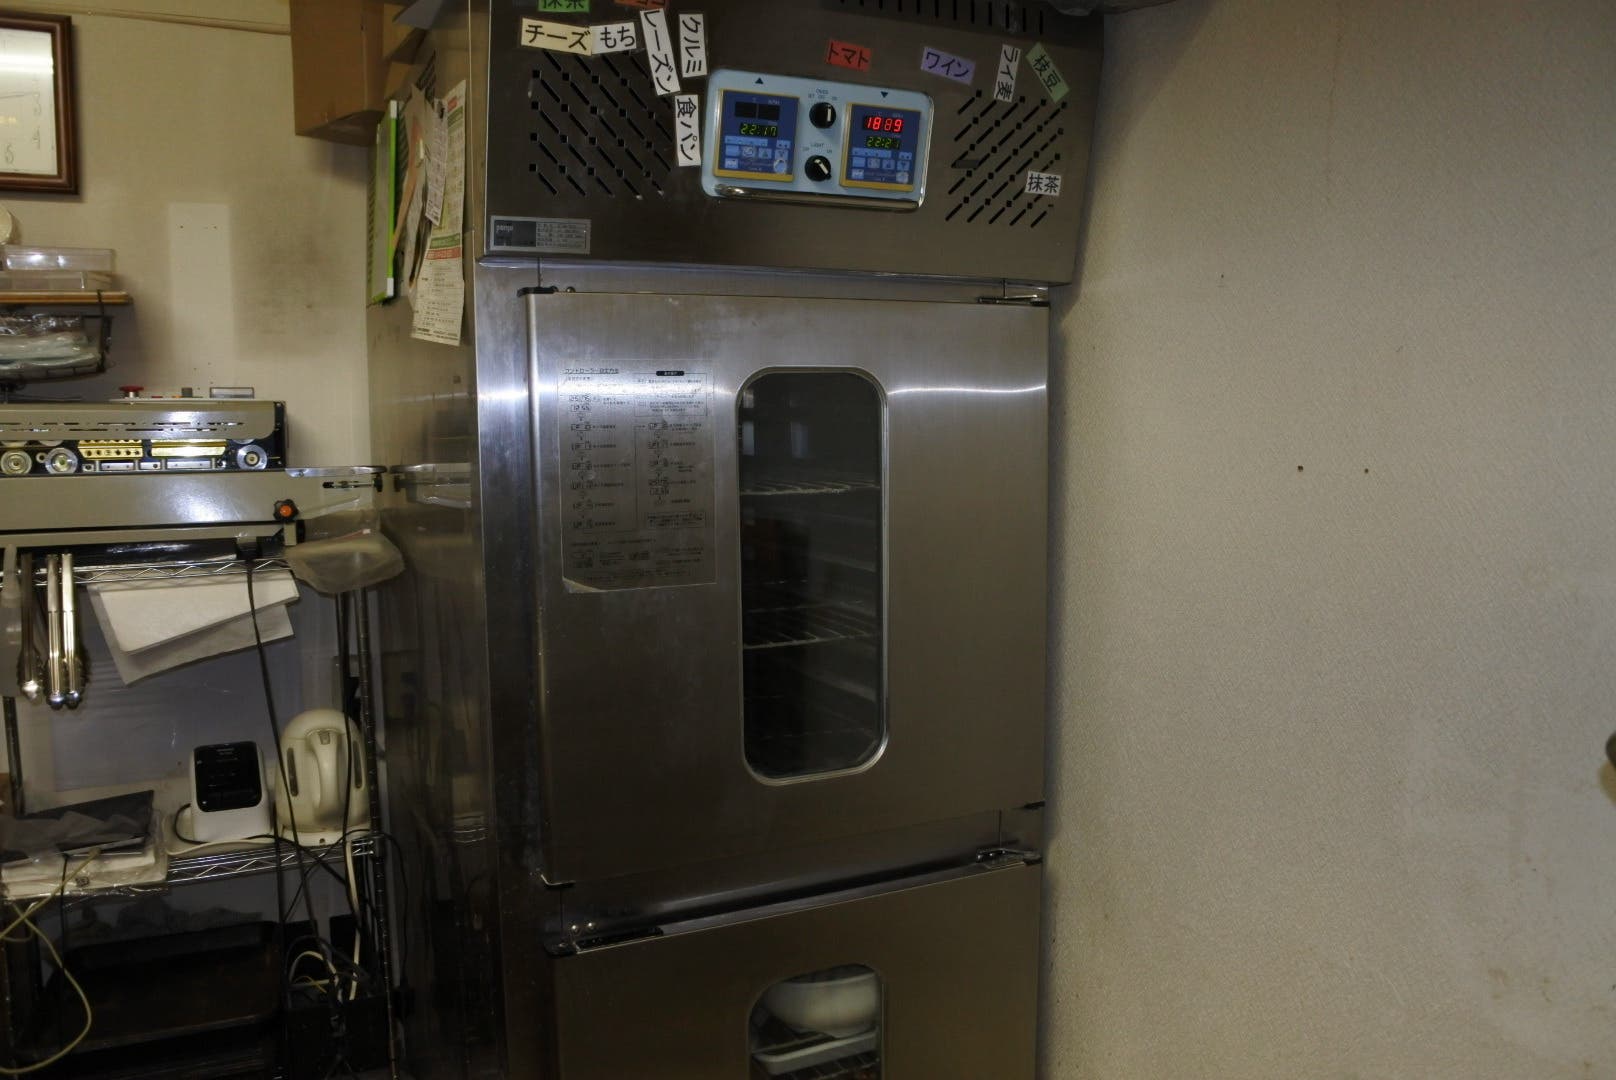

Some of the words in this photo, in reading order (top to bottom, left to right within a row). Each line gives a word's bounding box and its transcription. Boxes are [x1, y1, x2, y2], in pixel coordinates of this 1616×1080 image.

[525, 24, 591, 51] チーズ
[600, 26, 636, 49] もち
[643, 10, 675, 93] レーズン
[682, 16, 702, 73] クルミ
[827, 43, 869, 66] トマト
[925, 51, 970, 78] ワイン
[995, 47, 1018, 100] ライ麦
[1033, 54, 1061, 93] 枝豆
[675, 97, 698, 161] 食パン
[1028, 175, 1061, 194] 抹茶
